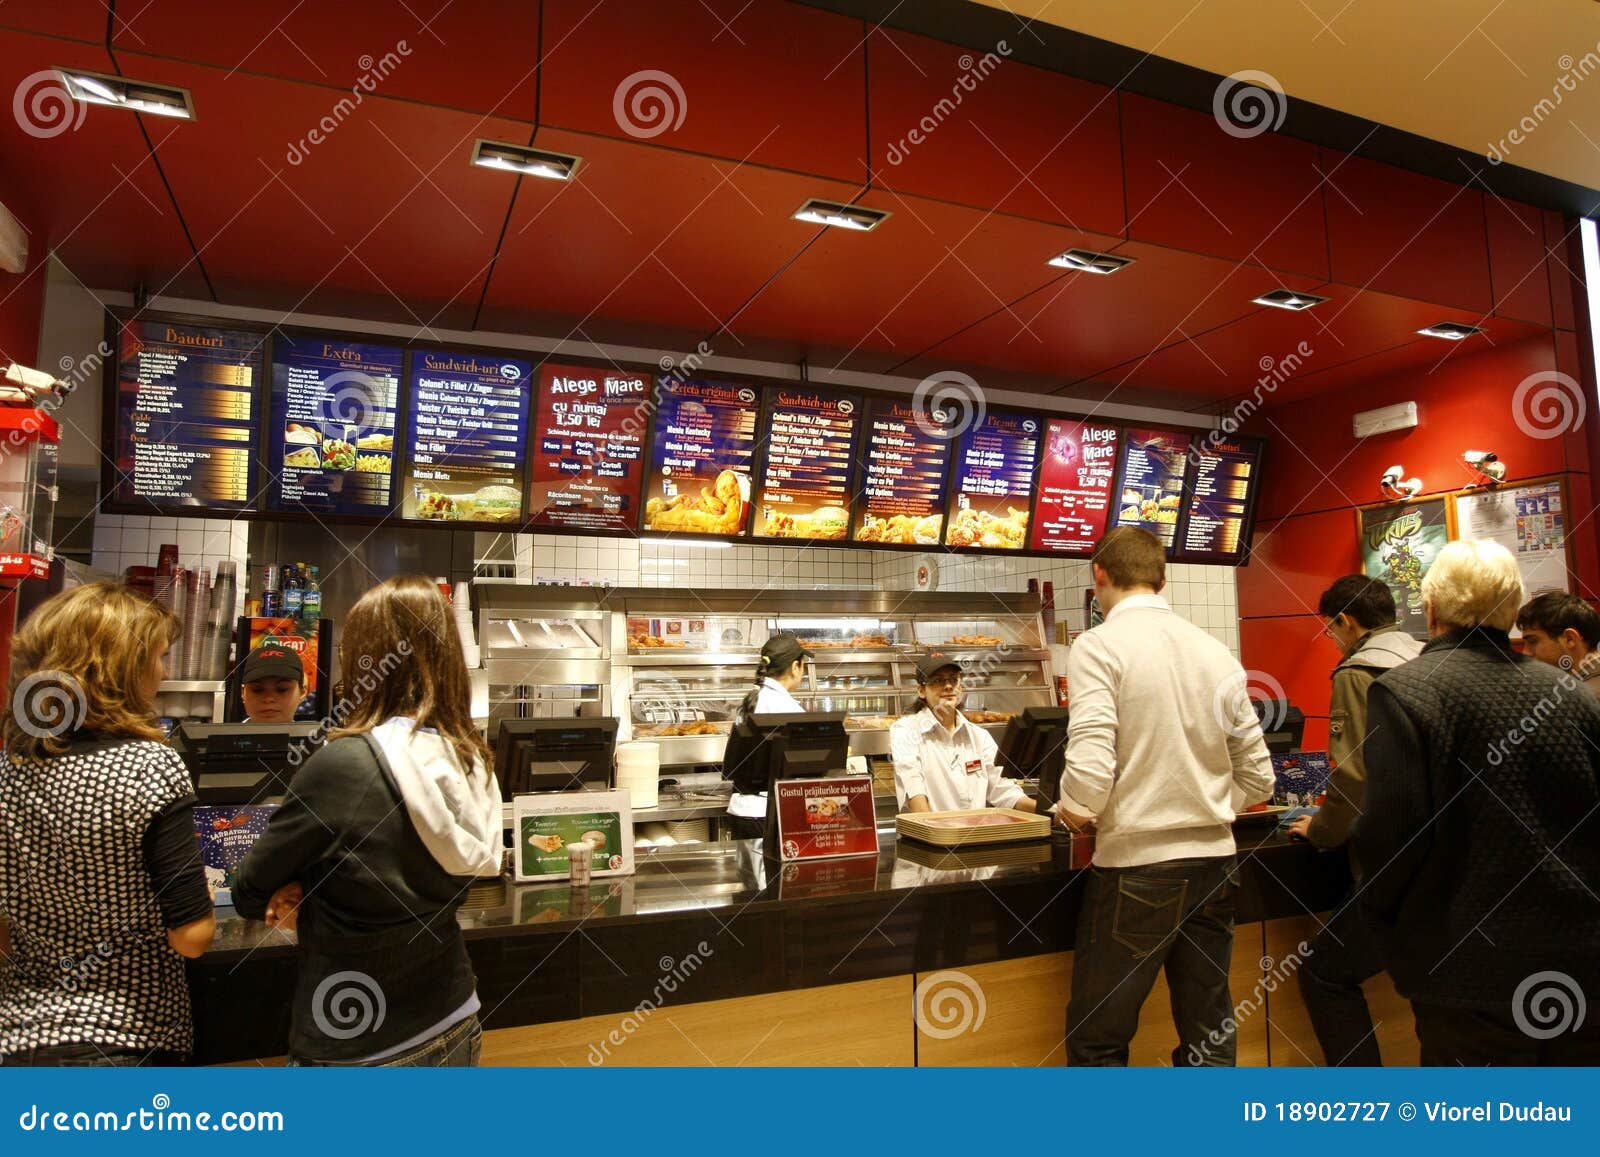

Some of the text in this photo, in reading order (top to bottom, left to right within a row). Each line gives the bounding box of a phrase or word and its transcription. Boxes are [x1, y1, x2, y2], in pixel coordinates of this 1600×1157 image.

[322, 344, 361, 361] Extra
[425, 354, 499, 374] Sandwich-uri
[552, 377, 644, 395] Alege Mare
[552, 402, 607, 416] cu numai
[778, 392, 837, 409] Sandwich-uri
[587, 415, 601, 428] lei
[1081, 427, 1117, 444] Alege
[1083, 445, 1114, 460] Mare
[780, 787, 804, 797] Gustul
[841, 784, 849, 793] de
